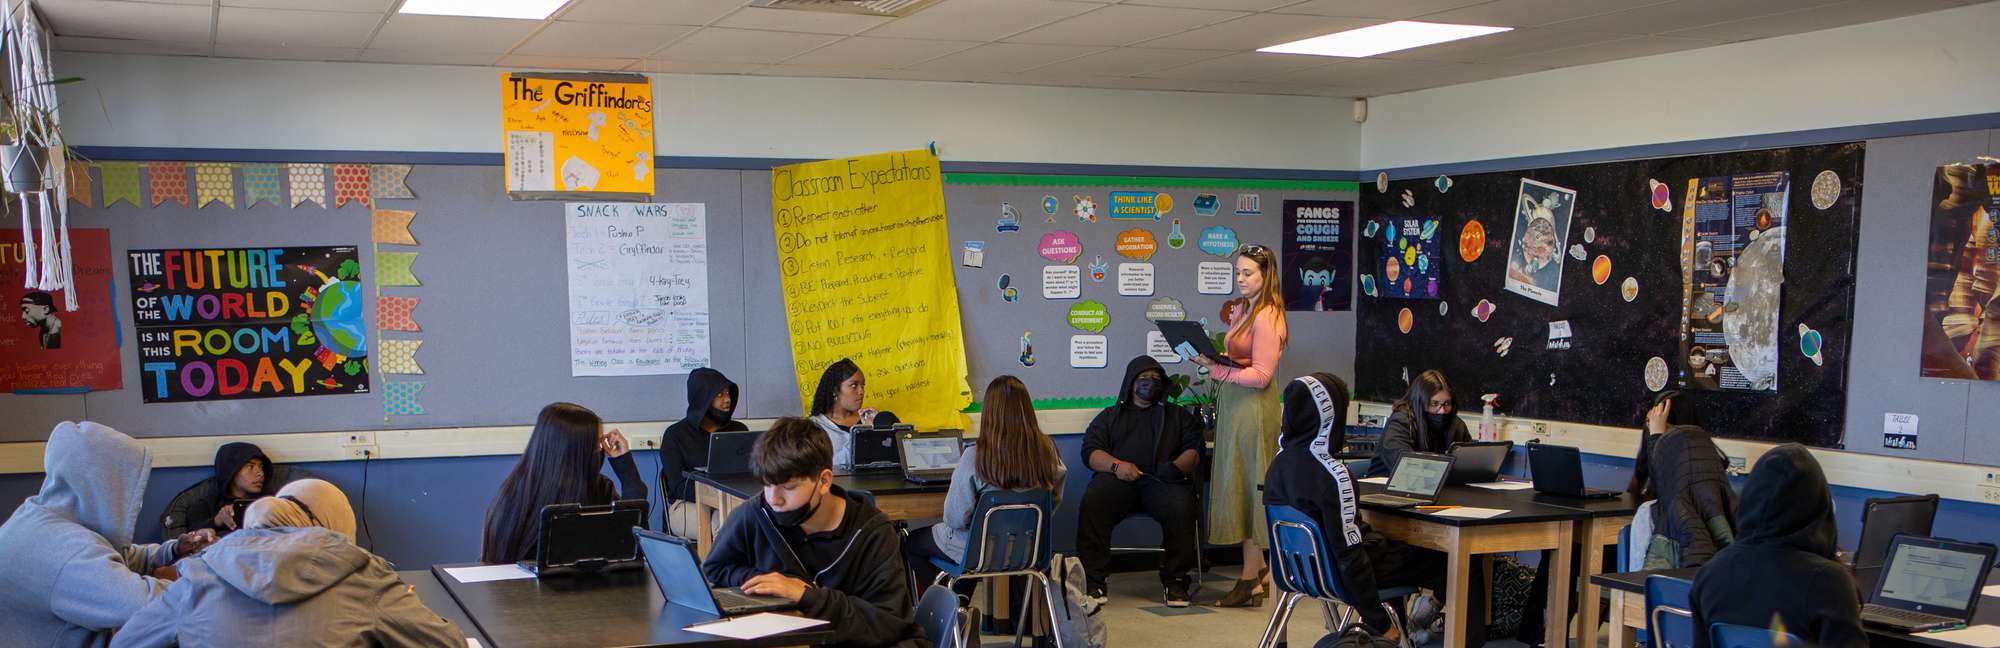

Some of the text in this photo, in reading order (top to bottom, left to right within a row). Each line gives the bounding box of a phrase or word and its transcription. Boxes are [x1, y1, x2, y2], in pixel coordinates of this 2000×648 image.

[509, 77, 543, 102] The
[774, 153, 930, 201] Classroom Expectations
[1114, 195, 1152, 203] THINK LIKE
[577, 205, 668, 217] SNACK WARS
[1296, 207, 1339, 219] FANGS
[1296, 224, 1339, 235] COUGH
[1404, 220, 1418, 228] SOLAR
[1403, 228, 1420, 236] SYSTEM
[1042, 246, 1077, 255] QUESTIONS
[130, 249, 287, 290] THE FUTURE
[137, 297, 157, 309] OF
[137, 291, 289, 321] THE WORLD
[1072, 317, 1104, 325] EXPERIMENT
[142, 332, 169, 342] IS IN
[143, 326, 289, 357] THIS ROOM
[144, 357, 312, 399] TODAY
[1312, 384, 1333, 413] ECKO
[1327, 460, 1350, 483] ECKO
